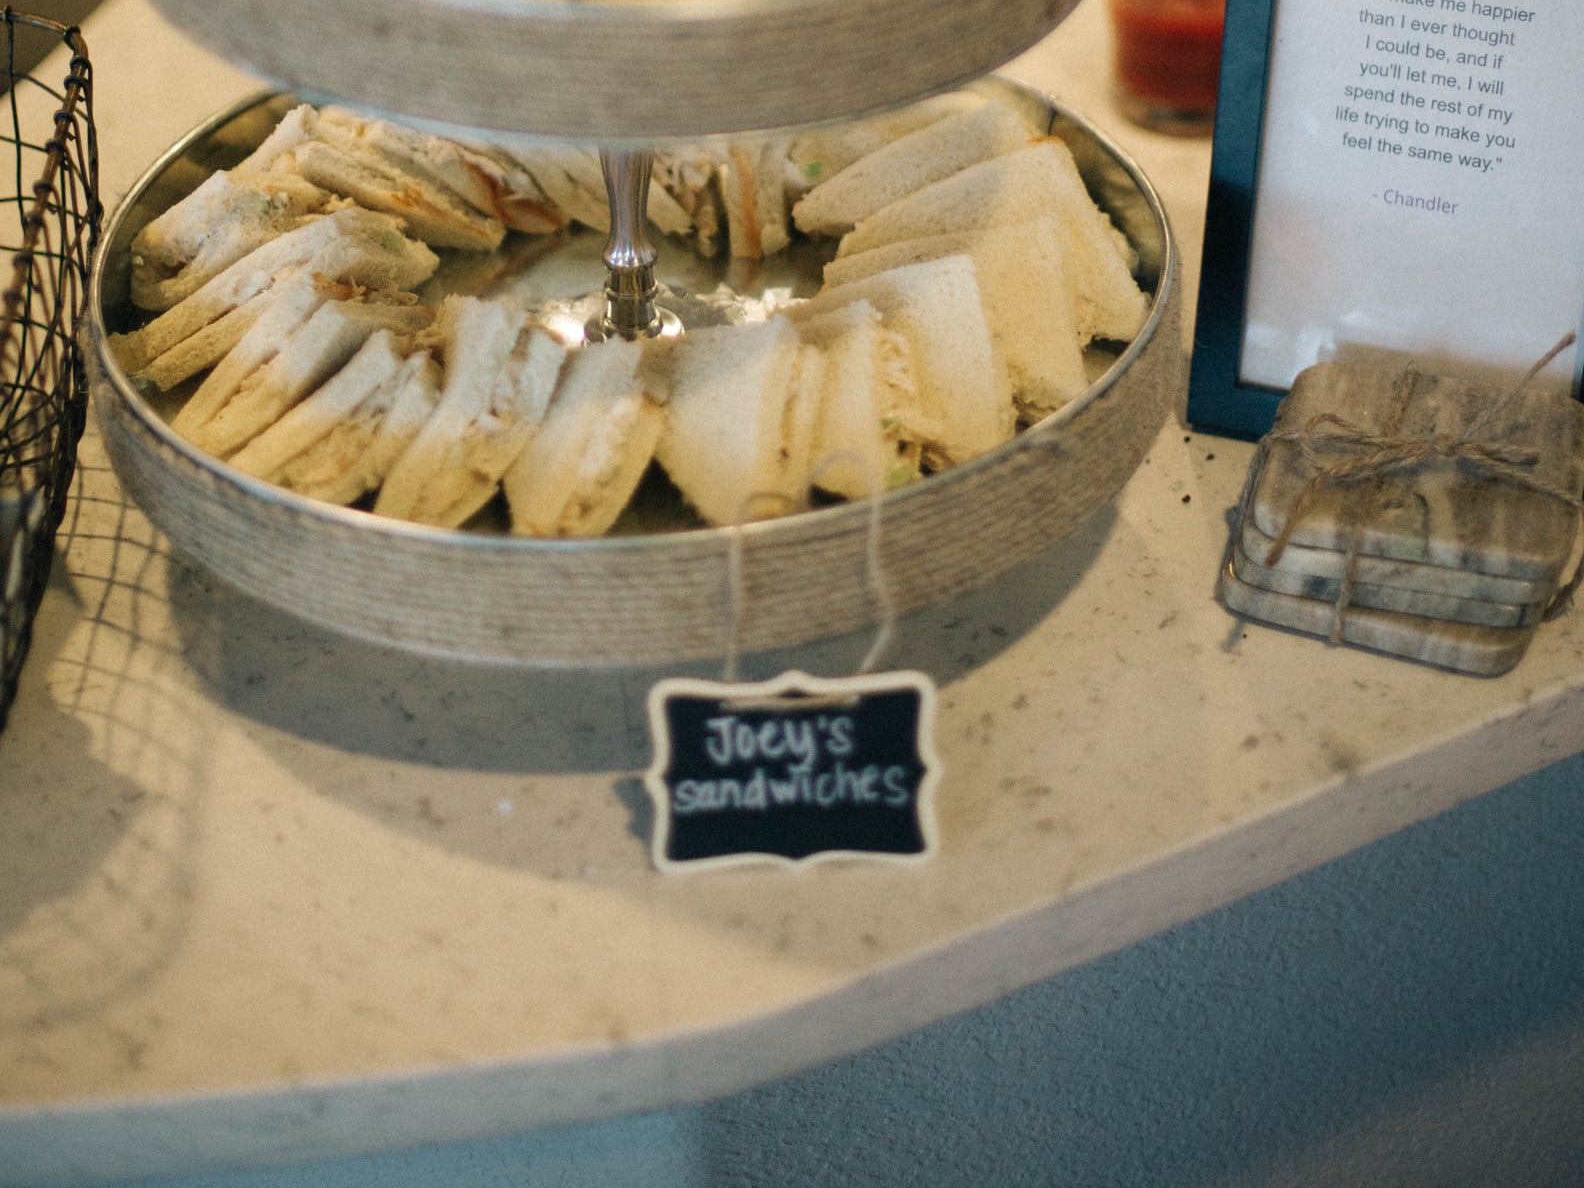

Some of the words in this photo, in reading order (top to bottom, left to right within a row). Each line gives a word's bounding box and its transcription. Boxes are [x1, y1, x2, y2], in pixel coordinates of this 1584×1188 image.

[1359, 9, 1395, 27] than
[1401, 14, 1406, 29] I
[1410, 19, 1448, 35] ever
[1452, 23, 1516, 47] thought
[1471, 0, 1536, 24] happier
[1365, 34, 1371, 49] I
[1375, 39, 1421, 57] could
[1425, 44, 1451, 63] be,
[1456, 52, 1488, 68] and
[1492, 54, 1504, 70] if
[1359, 62, 1402, 79] you'll
[1406, 66, 1427, 84] let
[1431, 73, 1462, 91] me,
[1467, 76, 1473, 91] I
[1477, 80, 1504, 96] will
[1344, 85, 1395, 104] spend
[1400, 91, 1426, 109] the
[1430, 99, 1462, 116] rest
[1466, 103, 1484, 118] of
[1487, 108, 1514, 127] my
[1335, 105, 1359, 123] life
[1364, 111, 1409, 134] trying
[1414, 119, 1430, 135] to
[1434, 125, 1481, 143] make
[1485, 133, 1517, 149] you
[1342, 132, 1373, 151] feel
[1377, 139, 1403, 155] the
[1407, 146, 1453, 164] same
[1458, 154, 1503, 174] way."
[1383, 189, 1459, 215] Chandler
[705, 715, 855, 766] Joey's
[673, 762, 910, 814] sandwiches
